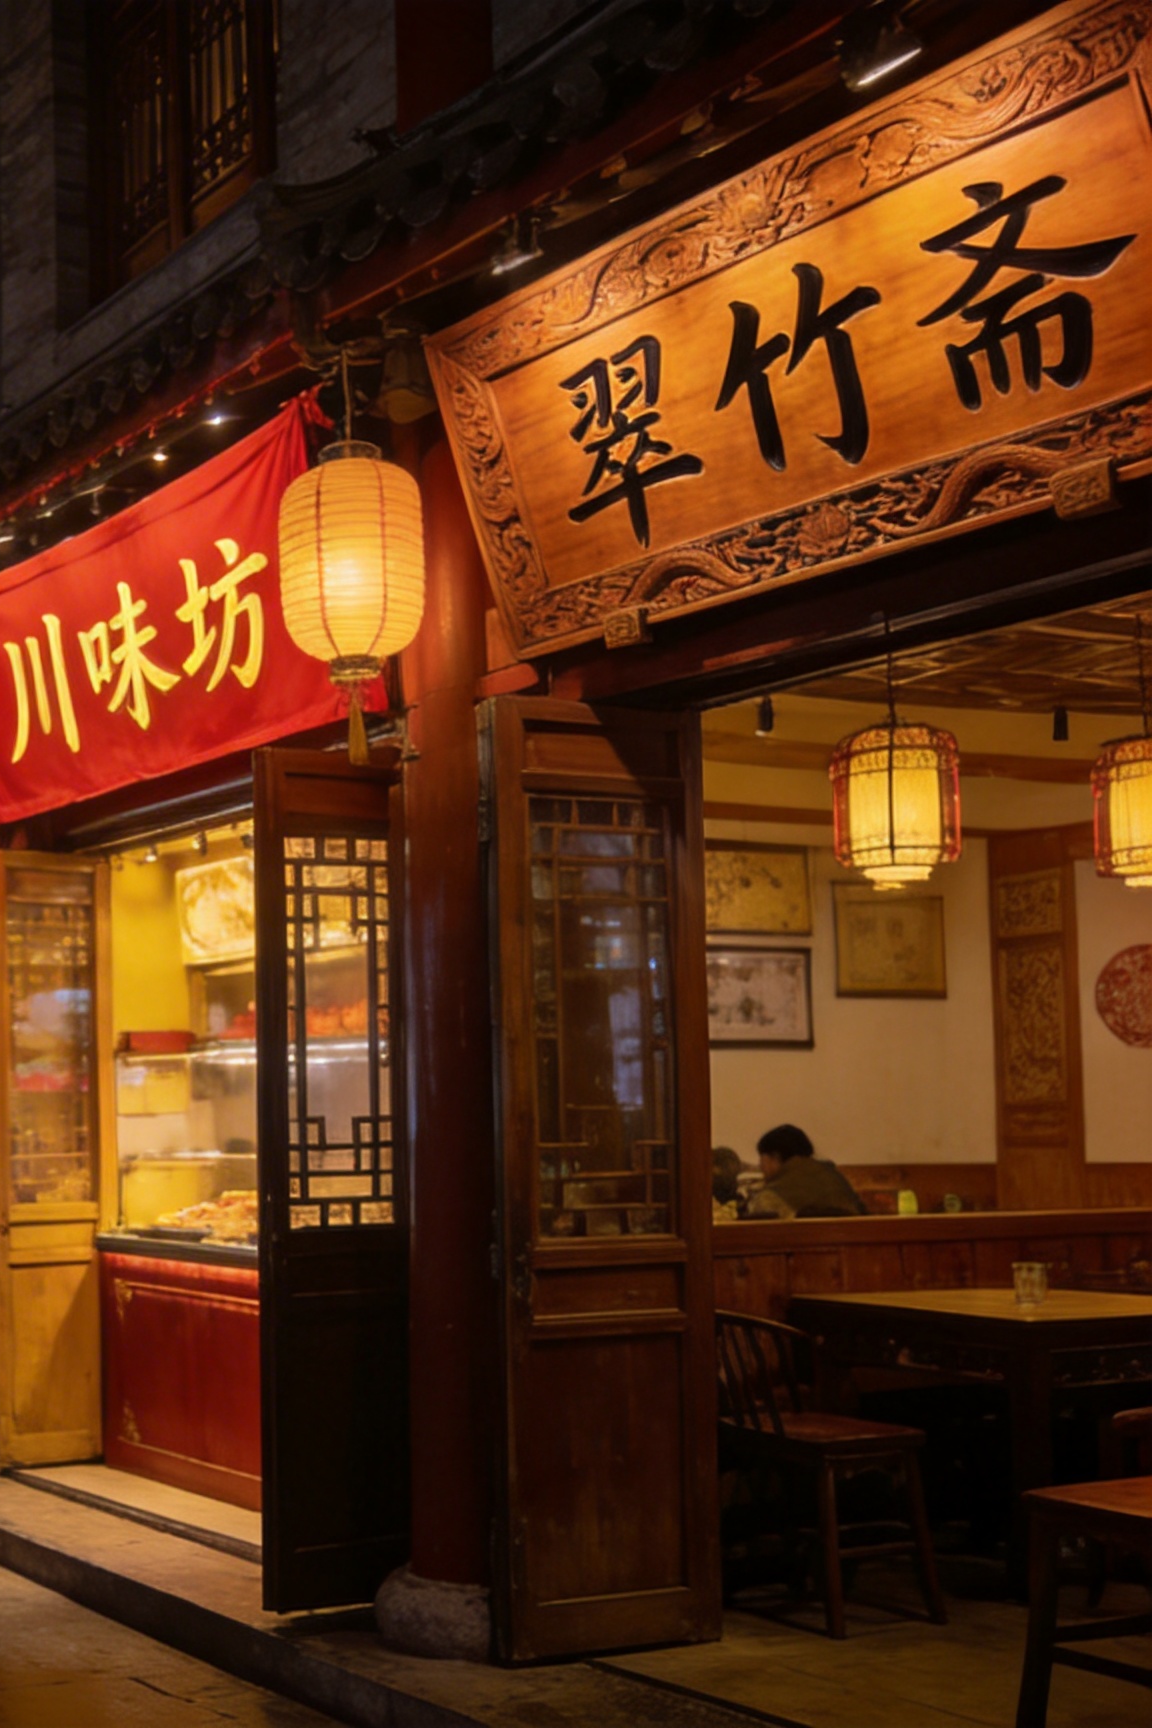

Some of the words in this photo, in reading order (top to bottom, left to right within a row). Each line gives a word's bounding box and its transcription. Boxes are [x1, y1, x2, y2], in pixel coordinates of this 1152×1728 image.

[559, 174, 1138, 548] 翠竹斋
[3, 537, 268, 764] 川味坊
